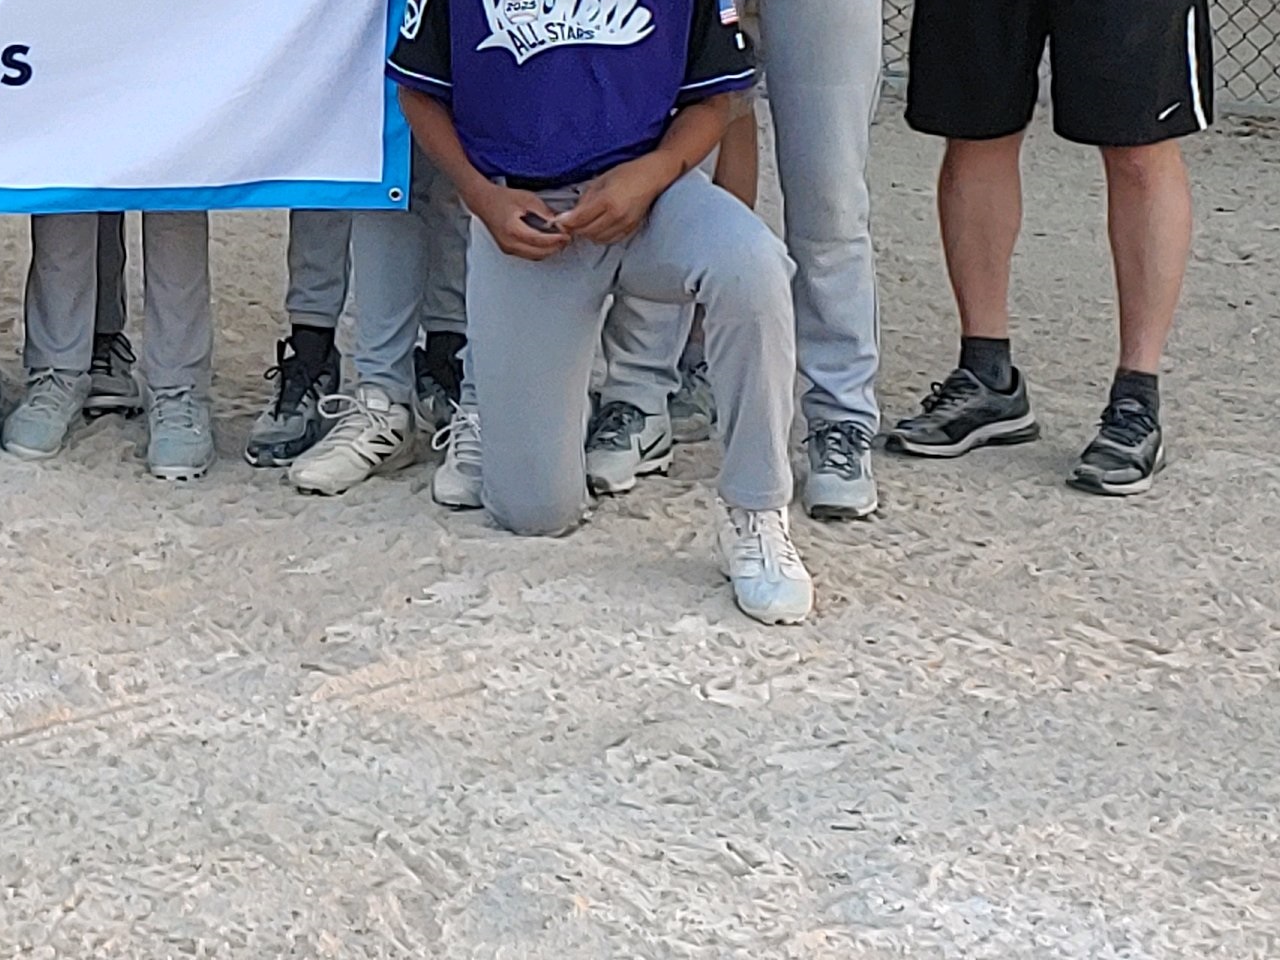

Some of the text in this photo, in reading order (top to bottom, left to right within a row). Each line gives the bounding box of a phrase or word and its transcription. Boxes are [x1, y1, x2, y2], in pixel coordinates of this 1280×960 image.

[506, 0, 538, 12] 2025
[506, 22, 596, 57] ALL STARS
